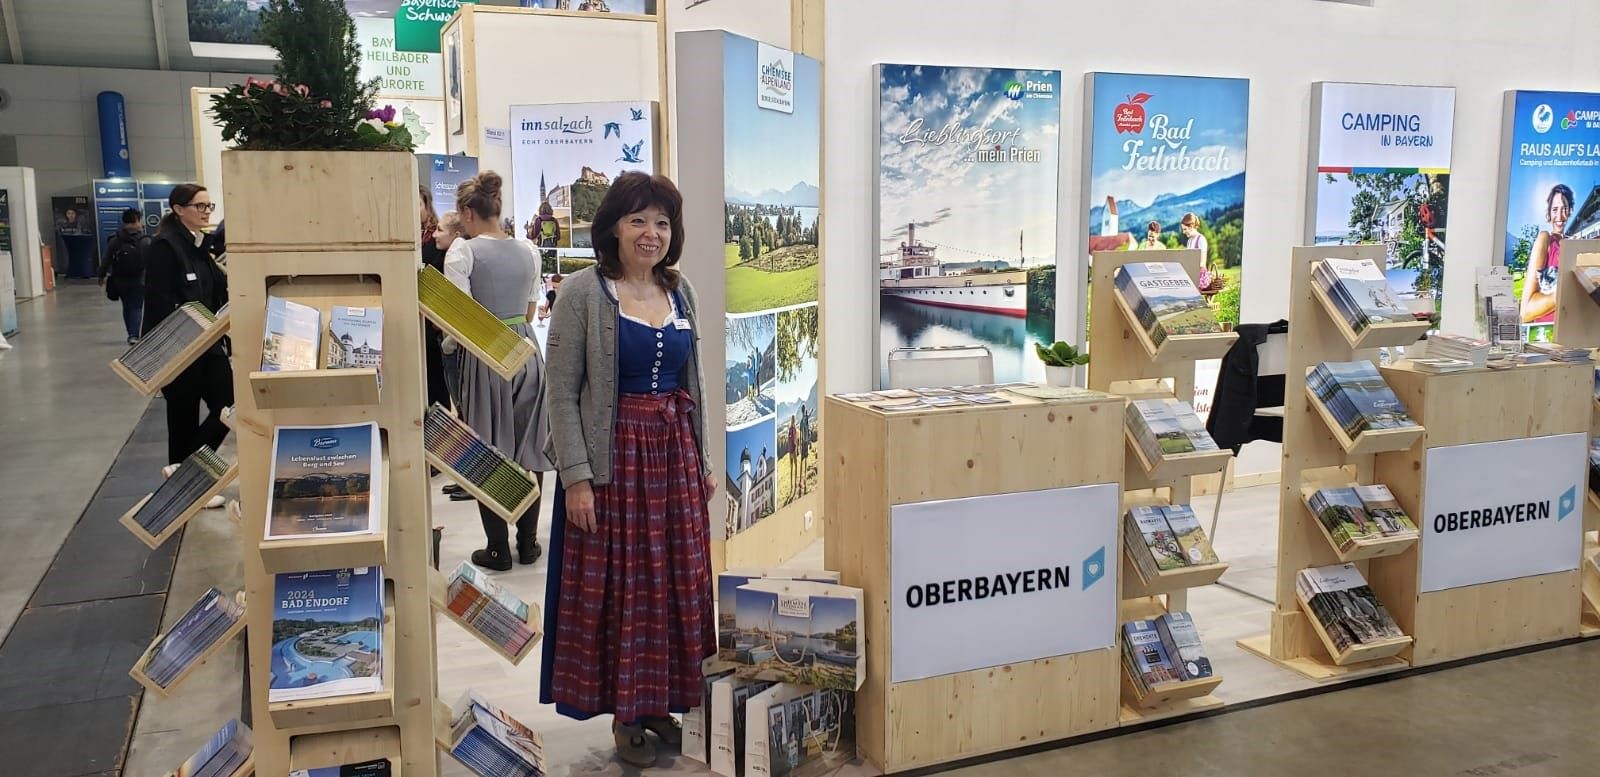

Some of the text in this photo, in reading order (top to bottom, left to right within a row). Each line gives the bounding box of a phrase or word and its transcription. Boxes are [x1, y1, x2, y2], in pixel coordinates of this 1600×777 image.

[406, 7, 456, 22] Schwa
[371, 37, 394, 48] BAY
[386, 66, 411, 77] UND
[761, 63, 792, 82] CHIEMSEE
[377, 79, 425, 91] URORTE
[761, 75, 792, 91] ALPENLAND
[1026, 80, 1053, 92] Prien
[1341, 112, 1421, 132] CAMPING
[899, 118, 1021, 154] Lieblingsort
[1149, 113, 1195, 148] Bad
[1381, 134, 1434, 147] IN BAYERN
[978, 148, 1004, 163] mein
[1010, 147, 1041, 163] Prien
[1121, 139, 1231, 171] Feilnbach
[1520, 143, 1552, 157] RAUS
[1519, 158, 1543, 168] Camping
[1139, 279, 1191, 288] GASTGEBER
[326, 453, 357, 461] zwischen
[1433, 500, 1551, 534] OBERBAYERN
[905, 565, 1071, 609] OBERBAYERN
[287, 590, 315, 600] 2024
[281, 596, 350, 609] BAD ENDORF
